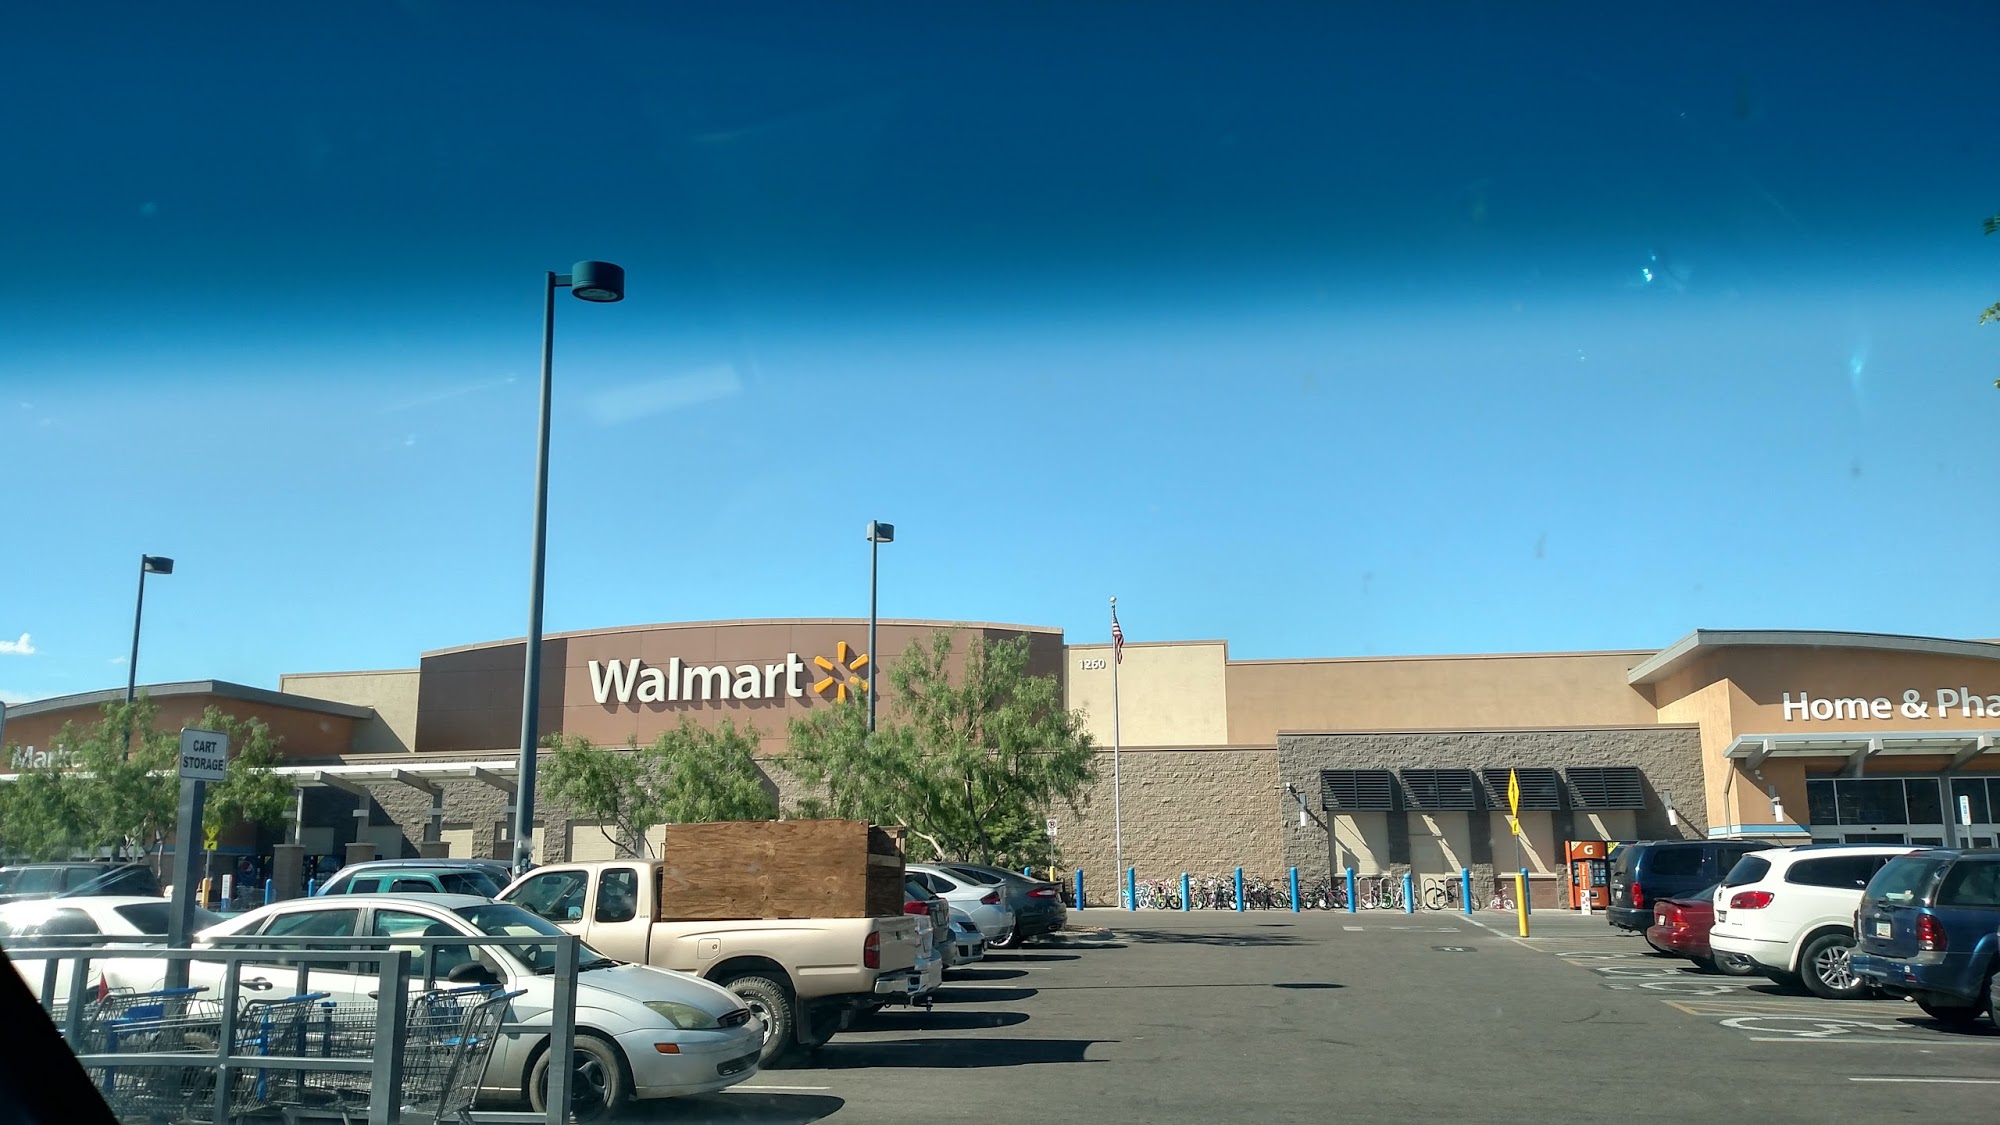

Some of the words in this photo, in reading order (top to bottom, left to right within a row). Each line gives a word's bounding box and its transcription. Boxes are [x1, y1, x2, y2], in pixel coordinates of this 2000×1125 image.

[1079, 659, 1106, 671] 1260
[588, 653, 804, 704] Walmart
[1782, 691, 1893, 721] Home
[1901, 689, 1930, 719] &
[193, 740, 217, 753] CART
[10, 743, 90, 770] Marke
[183, 756, 224, 771] STORAGE
[1583, 844, 1594, 855] G
